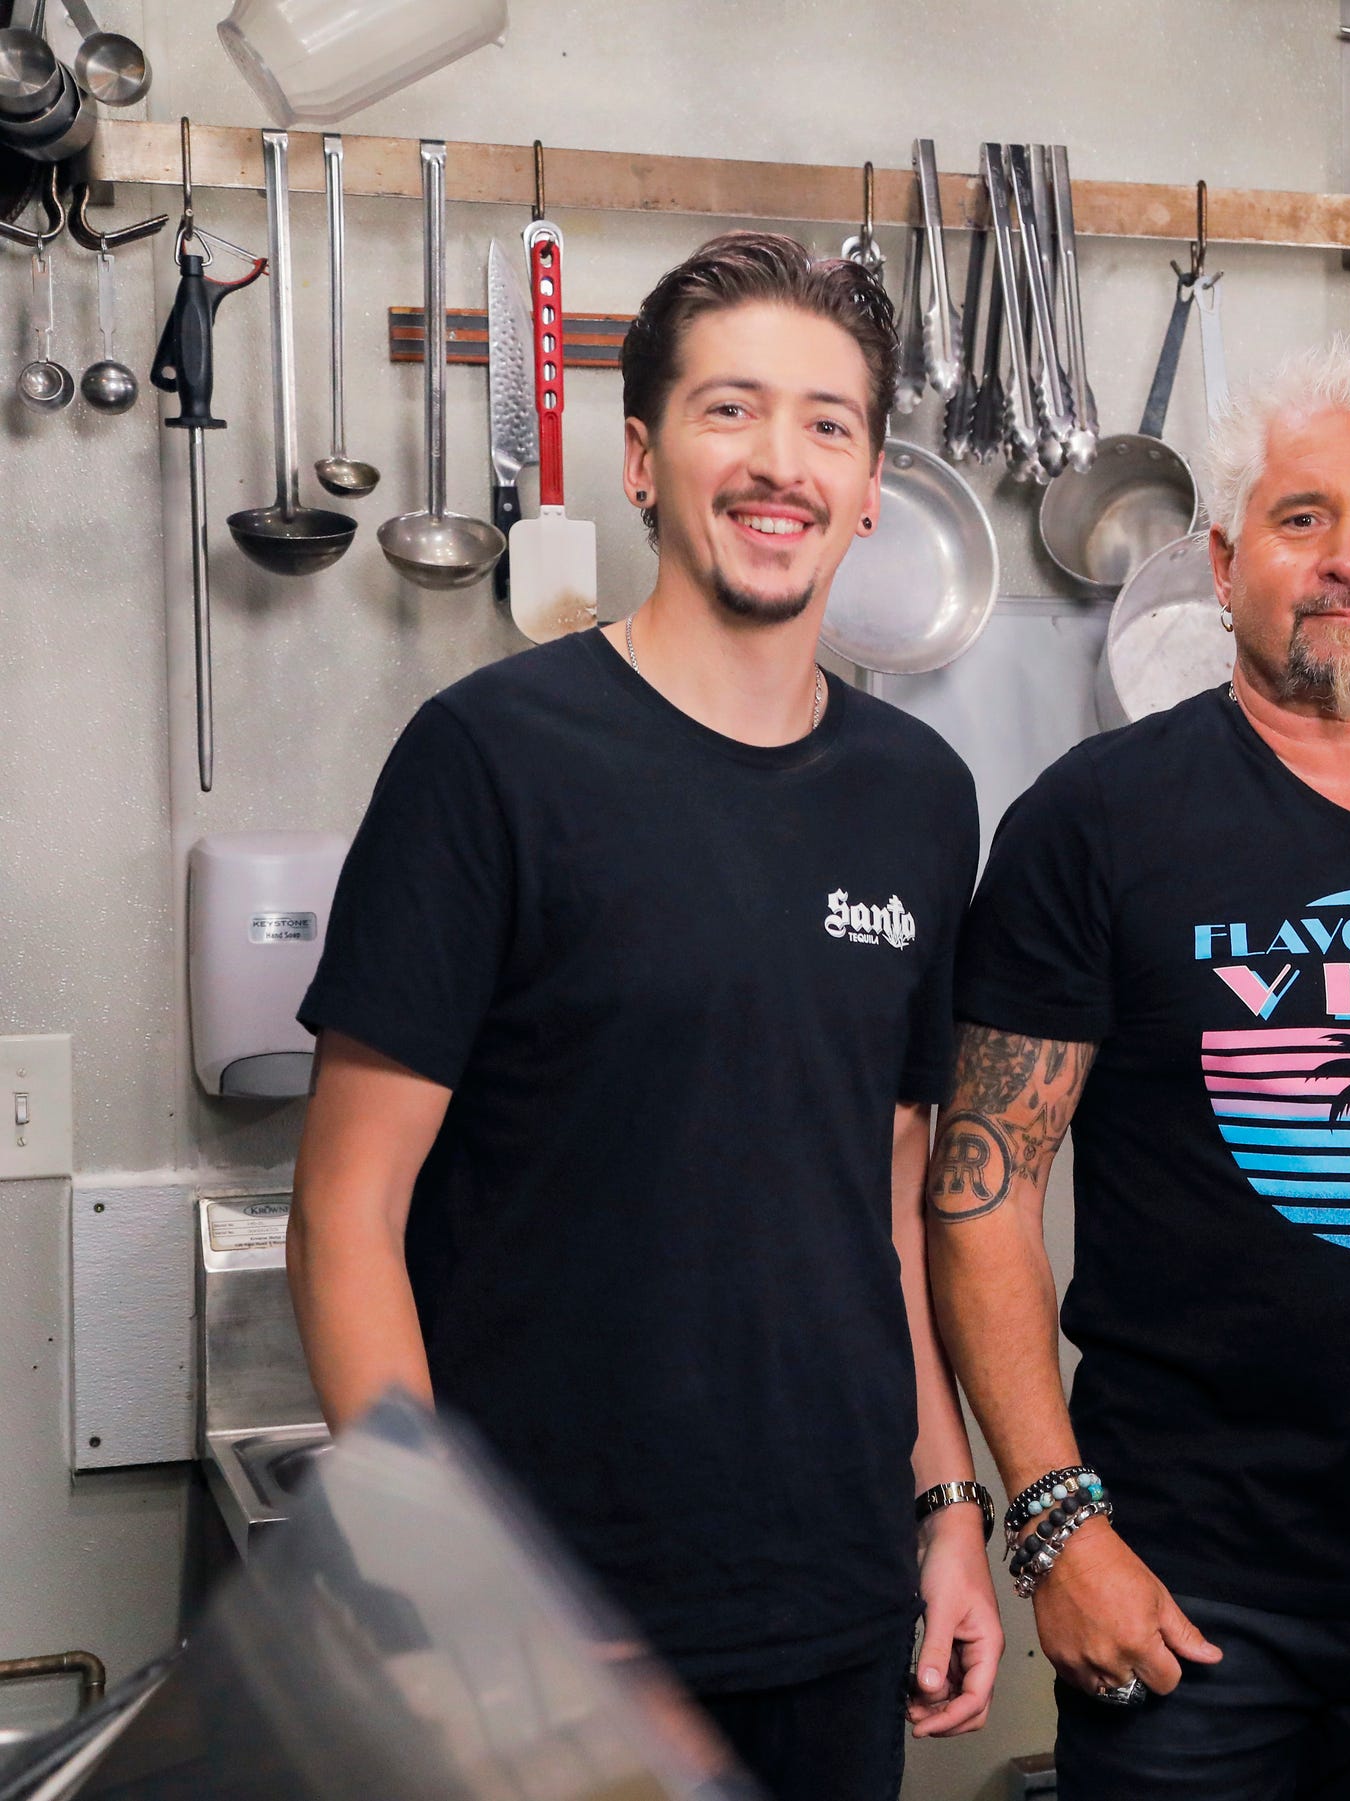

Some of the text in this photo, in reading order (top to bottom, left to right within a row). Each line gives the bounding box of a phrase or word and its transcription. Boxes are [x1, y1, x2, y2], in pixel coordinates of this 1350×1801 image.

[252, 919, 310, 928] KEYSTONE
[824, 887, 916, 951] Santo
[848, 931, 880, 945] TEQUILA
[250, 1205, 290, 1215] KROWN
